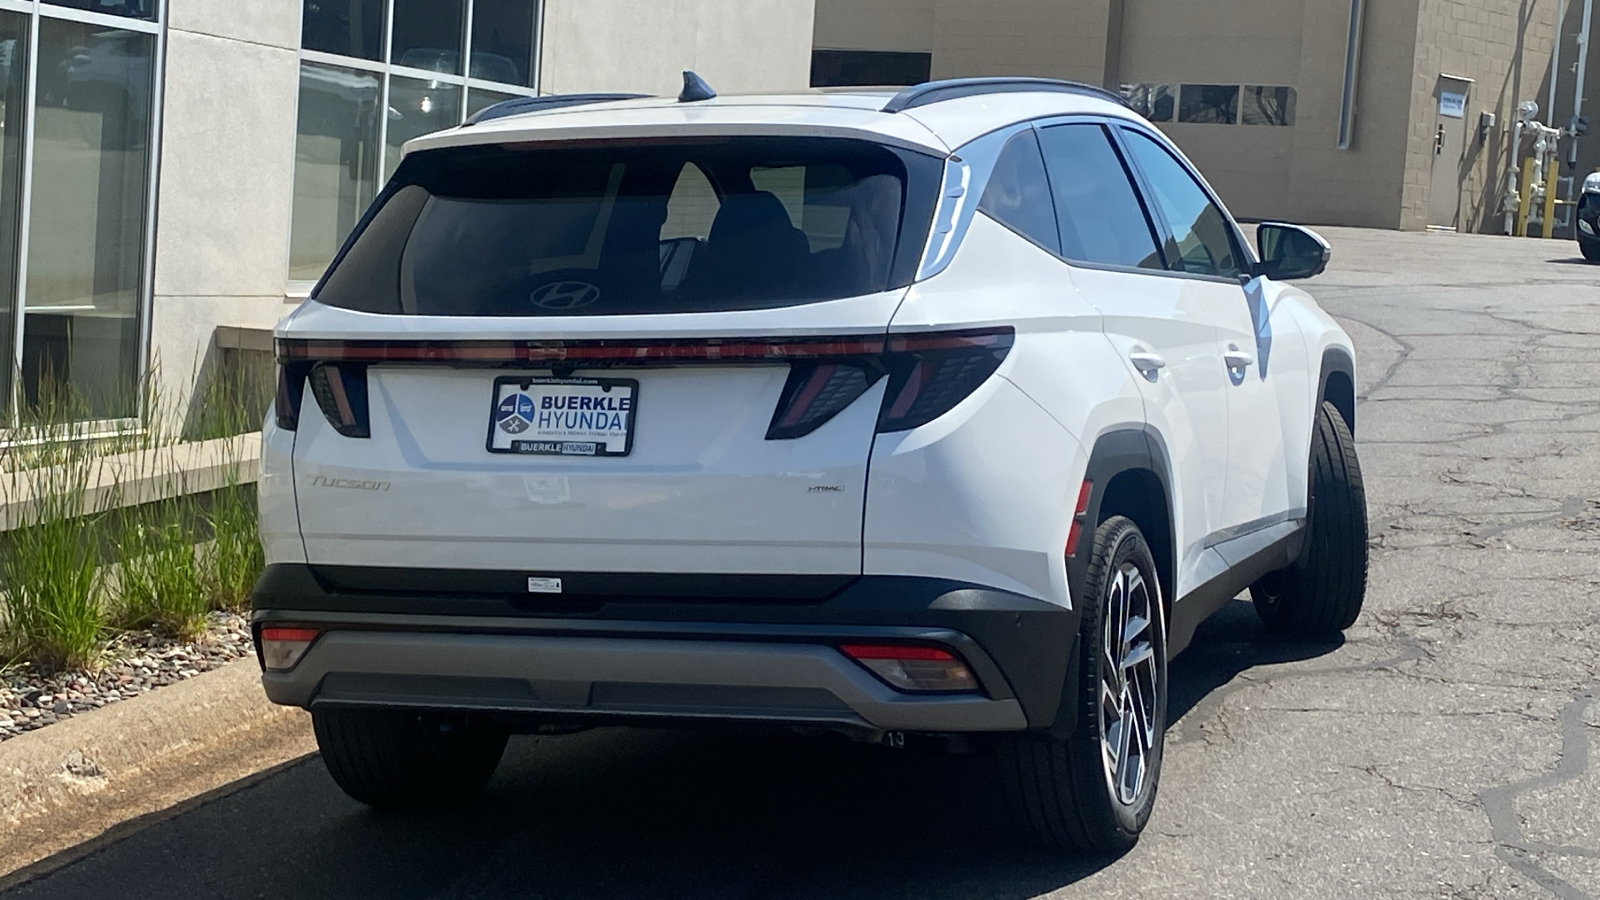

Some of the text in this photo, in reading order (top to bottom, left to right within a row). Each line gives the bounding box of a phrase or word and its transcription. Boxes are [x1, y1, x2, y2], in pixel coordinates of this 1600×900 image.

[541, 396, 630, 411] BUERKLE
[520, 442, 595, 453] BUERKLE HYUNDAI
